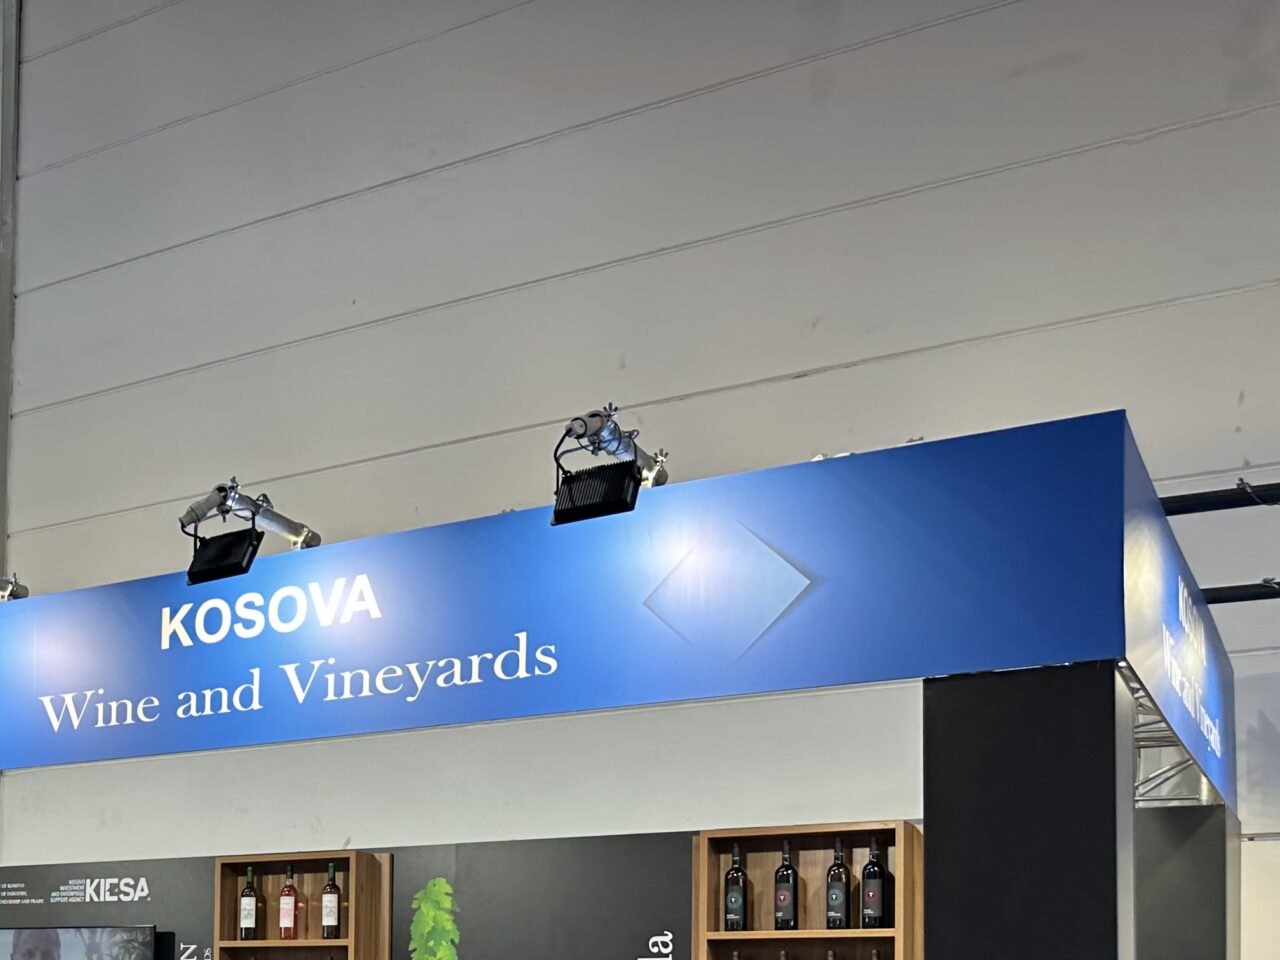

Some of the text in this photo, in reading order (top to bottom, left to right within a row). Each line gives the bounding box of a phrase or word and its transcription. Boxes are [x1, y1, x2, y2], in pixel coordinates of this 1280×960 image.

[160, 573, 382, 650] KOSOVA
[1178, 575, 1207, 667] KOSOVA
[38, 631, 559, 732] Wine and Vineyards
[85, 877, 150, 902] KIESA
